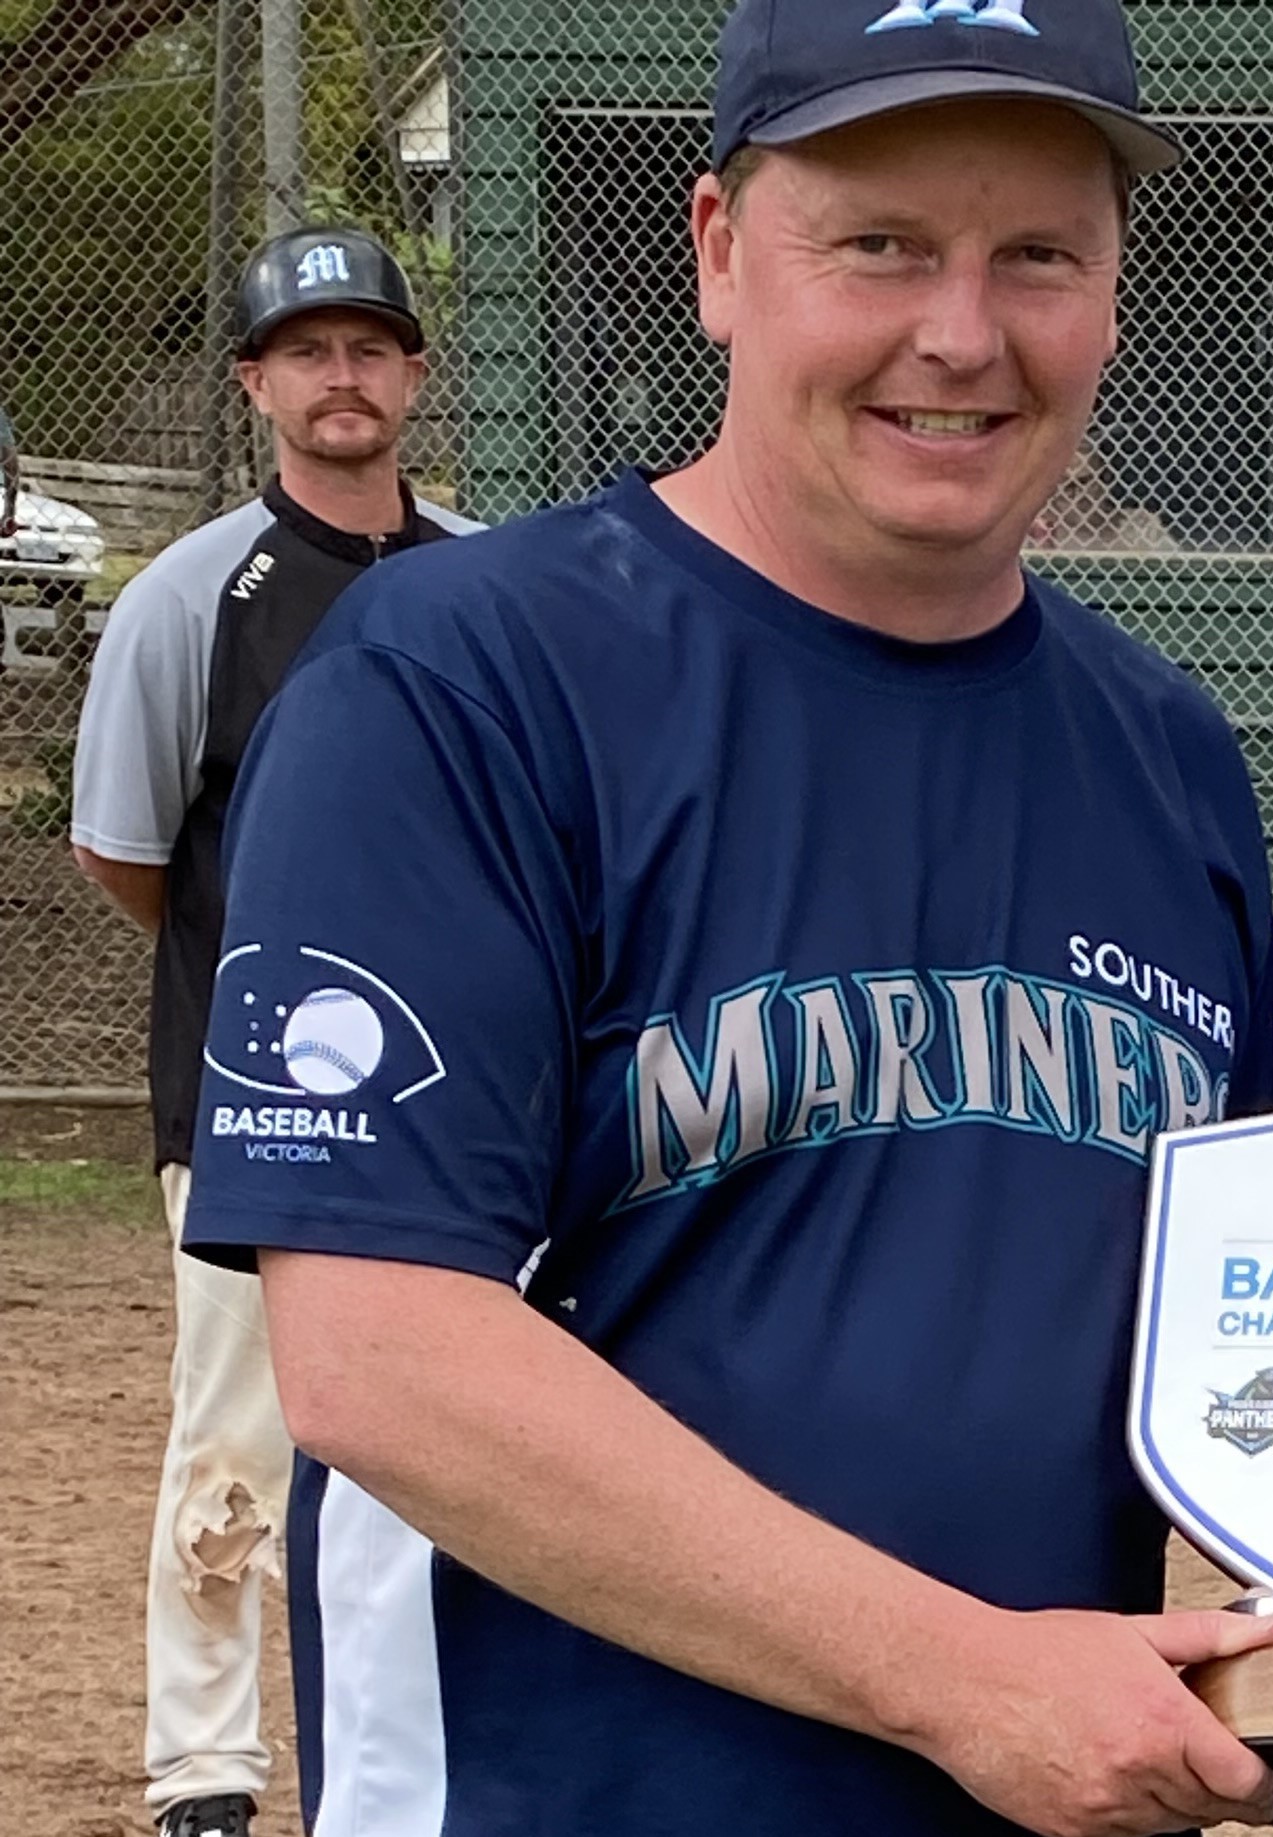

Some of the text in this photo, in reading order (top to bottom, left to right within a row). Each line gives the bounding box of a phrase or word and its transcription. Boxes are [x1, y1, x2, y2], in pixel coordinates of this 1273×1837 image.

[296, 243, 350, 289] M
[1069, 934, 1235, 1054] SOUTHER
[211, 1106, 377, 1143] BASEBALL
[245, 1142, 331, 1162] VICTORIA
